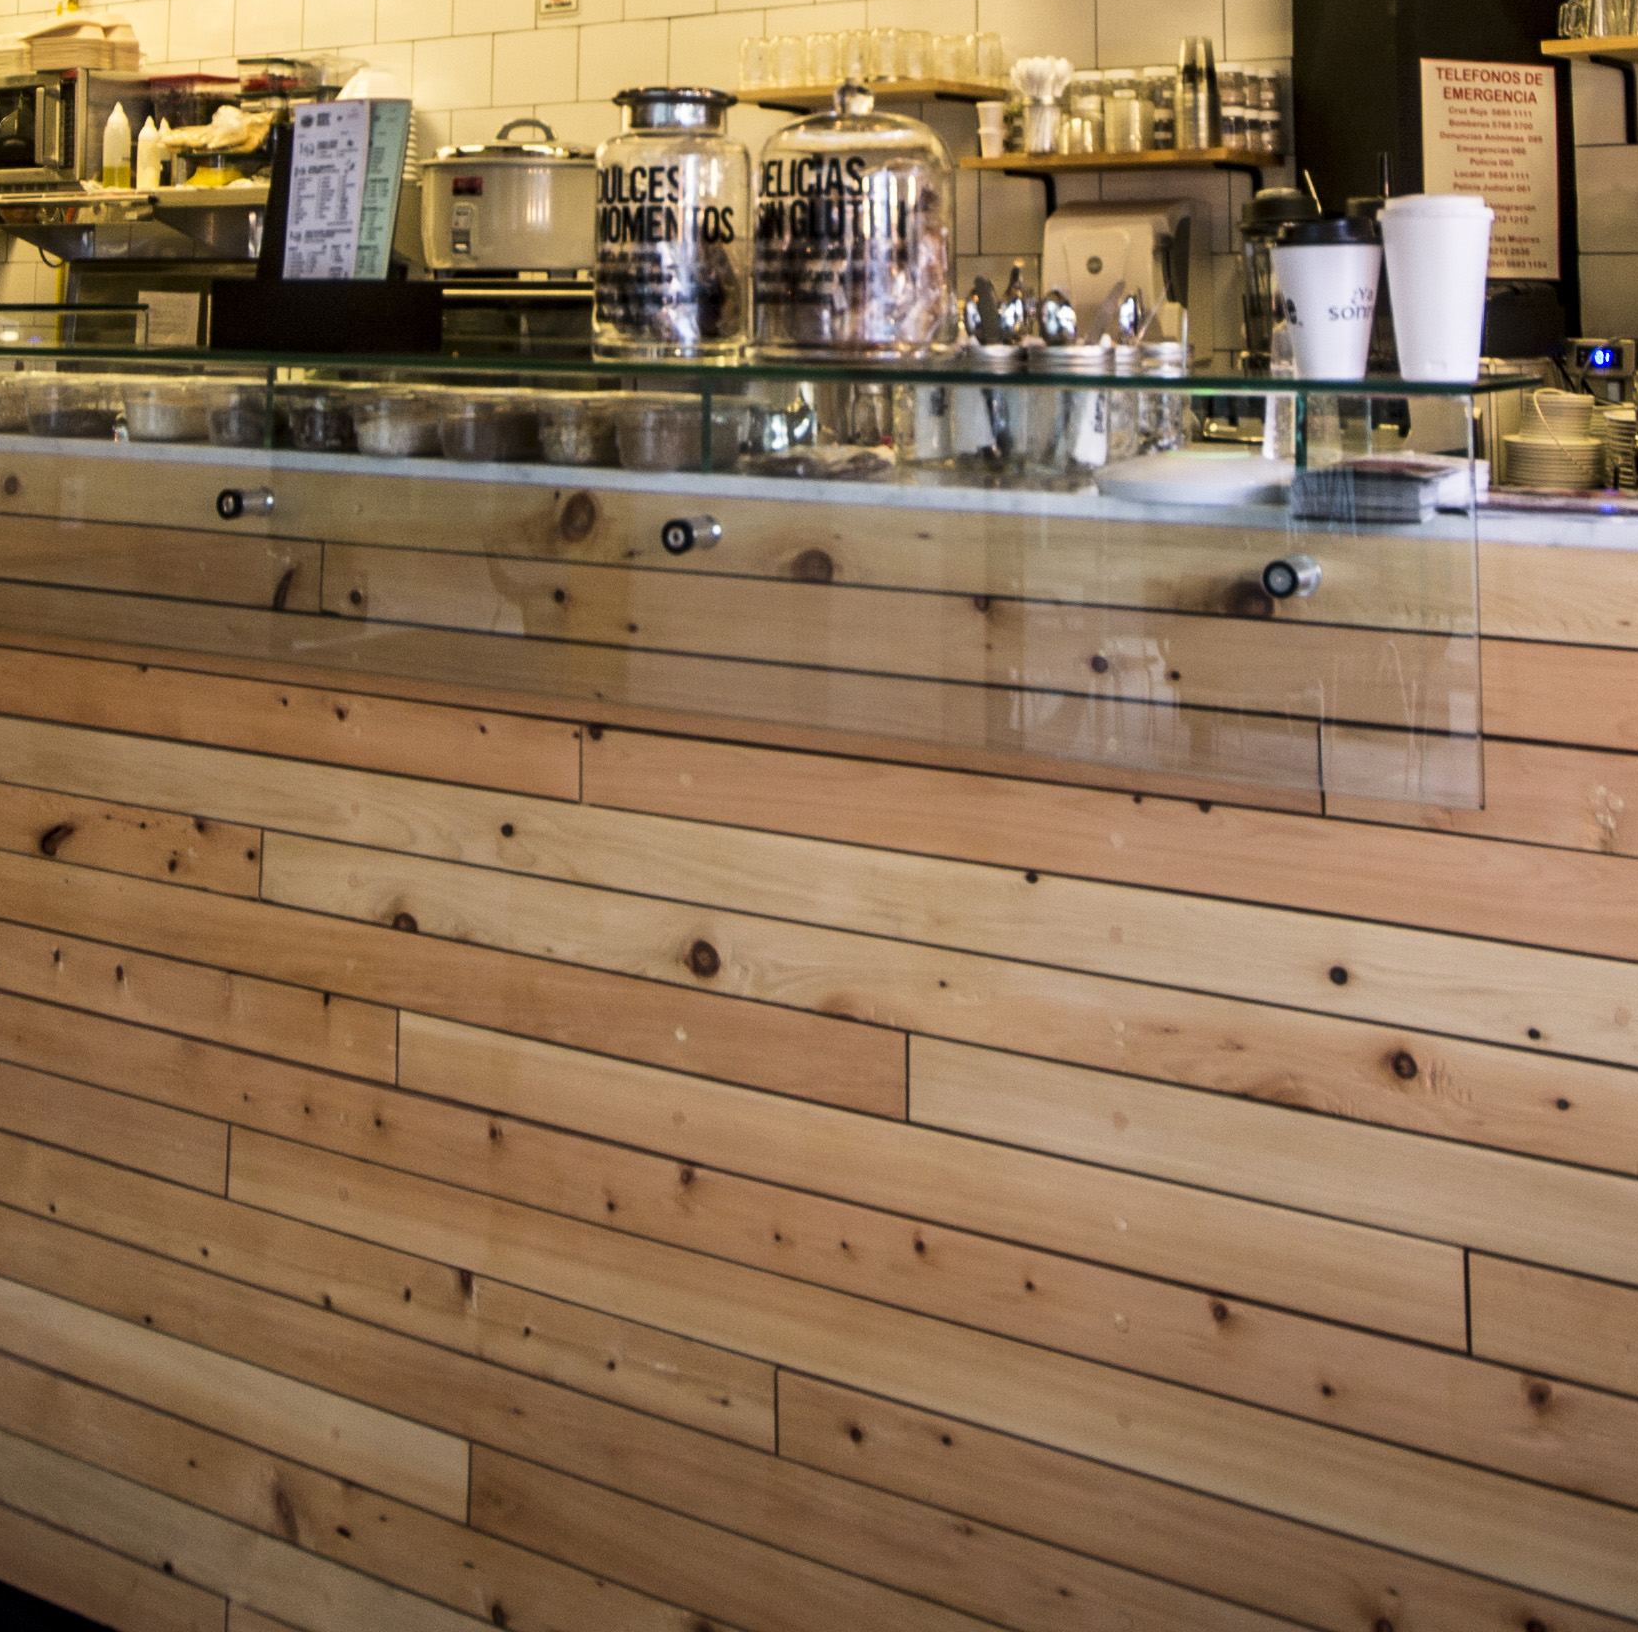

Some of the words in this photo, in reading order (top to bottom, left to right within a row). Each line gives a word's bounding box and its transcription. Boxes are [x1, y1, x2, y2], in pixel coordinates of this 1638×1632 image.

[1435, 66, 1521, 84] TELEFONOS
[1524, 72, 1542, 86] DE
[1443, 86, 1537, 104] EMERGENCIA
